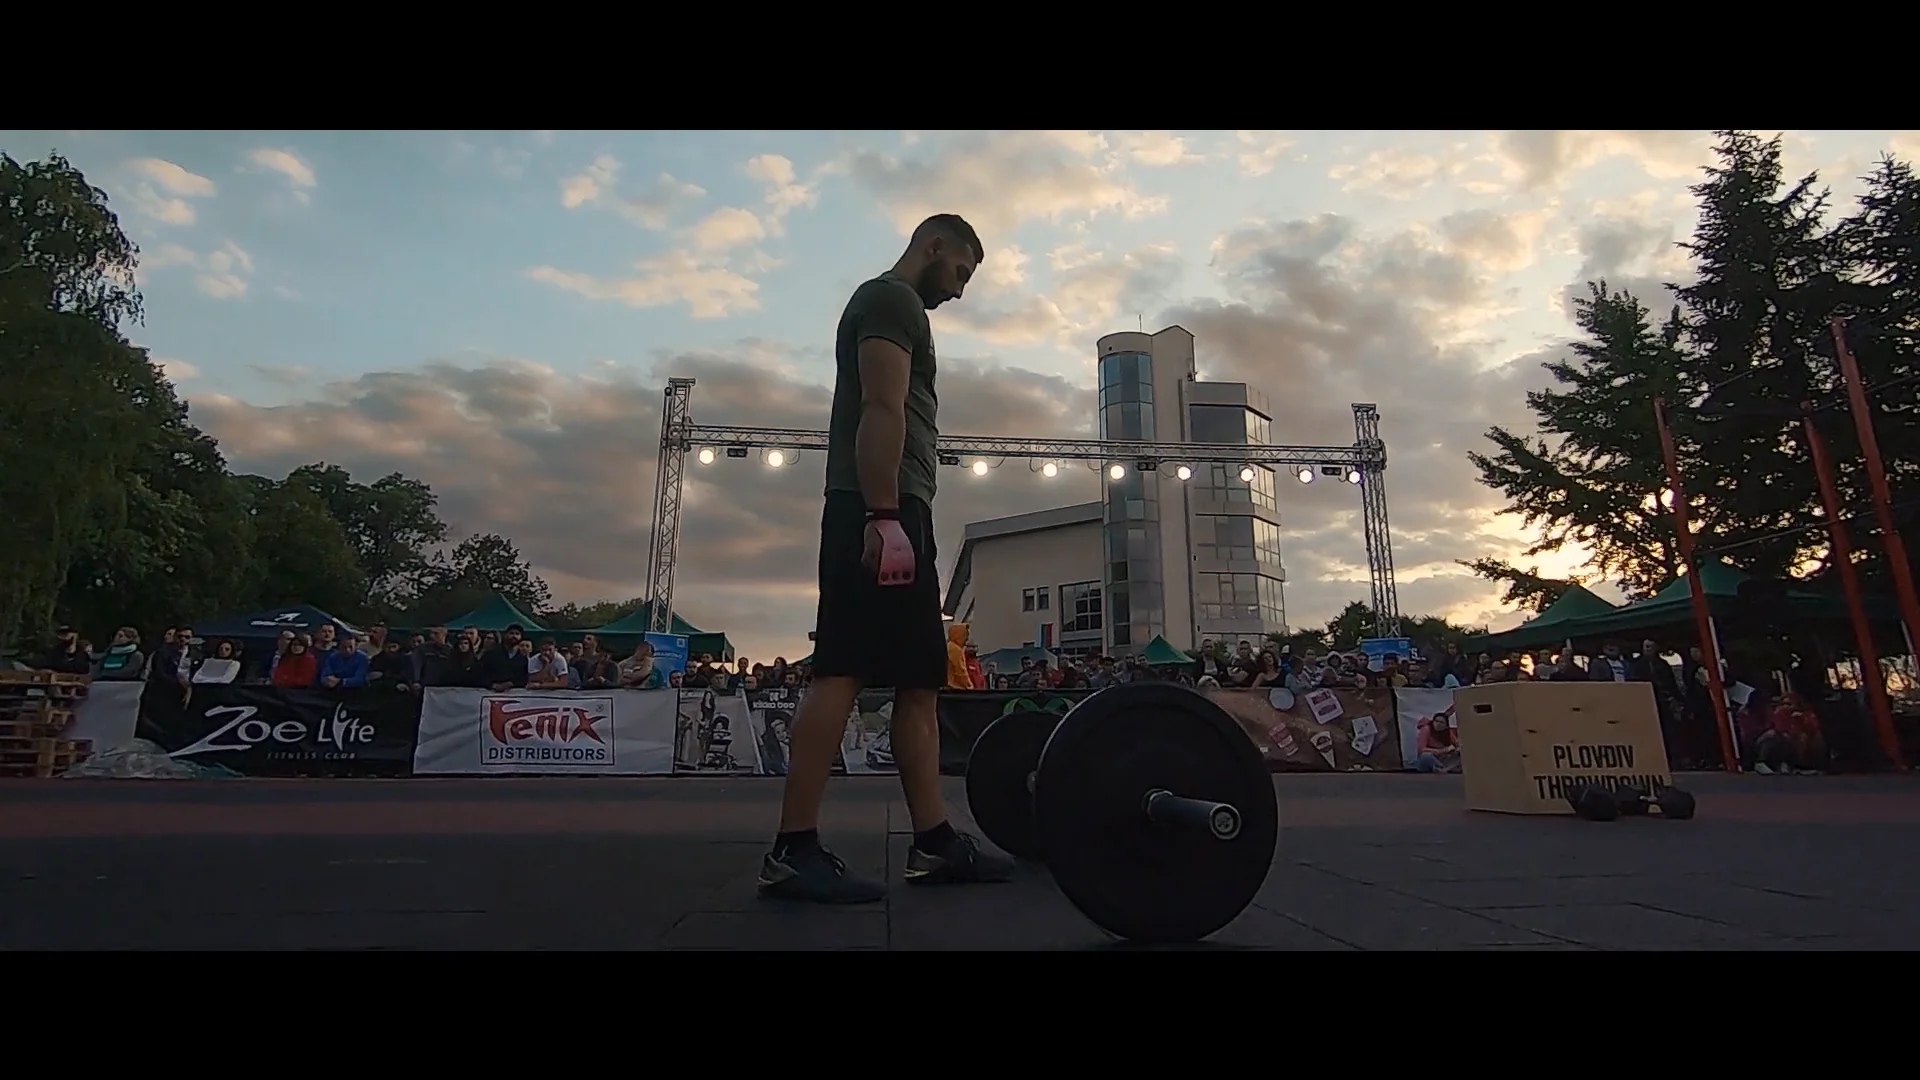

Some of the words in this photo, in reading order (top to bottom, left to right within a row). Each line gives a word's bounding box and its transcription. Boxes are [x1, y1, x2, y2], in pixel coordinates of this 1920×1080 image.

[169, 705, 307, 757] Zoe
[266, 751, 317, 760] FITNESS
[324, 751, 356, 760] CLUB
[488, 746, 606, 760] DISTRIBUTORS
[1553, 745, 1634, 769] PLOVDIV
